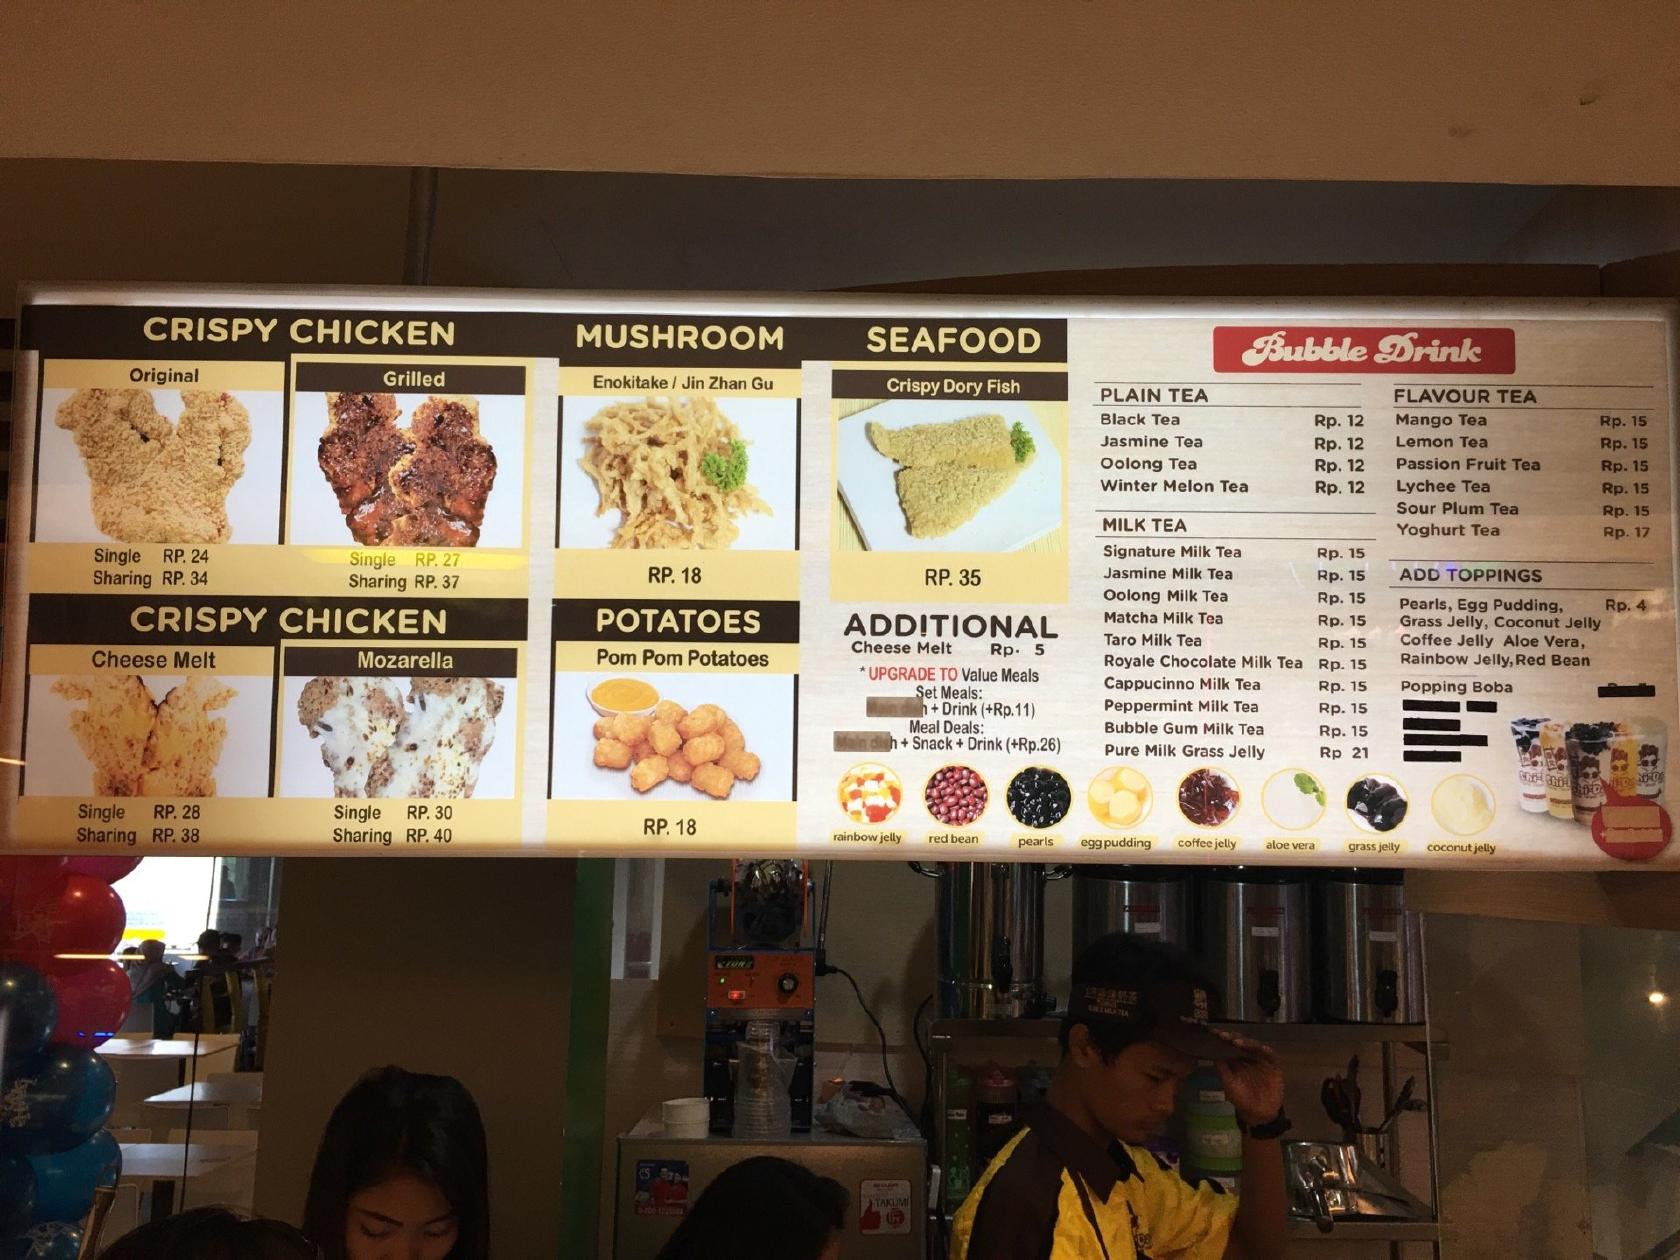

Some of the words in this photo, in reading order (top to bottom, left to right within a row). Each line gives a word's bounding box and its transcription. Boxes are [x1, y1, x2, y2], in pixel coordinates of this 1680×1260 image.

[144, 317, 278, 342] CRISPY
[290, 318, 455, 346] CHICKEN
[577, 324, 783, 350] MUSHROOM
[867, 326, 1041, 354] SEAFOOD
[1241, 331, 1368, 367] Bubble
[1373, 332, 1481, 363] Drink
[129, 367, 199, 385] Original
[383, 371, 445, 387] Grilled
[593, 375, 668, 389] Enokitake
[682, 376, 704, 389] Jin
[709, 376, 747, 390] Zhan
[752, 376, 773, 390] Gu
[887, 378, 940, 396] Crispy
[944, 379, 983, 396] Dory
[987, 379, 1020, 394] Fish
[1101, 388, 1161, 403] PLAIN
[1168, 388, 1208, 403] TEA
[1395, 389, 1490, 404] FLAVOUR
[1496, 389, 1537, 404] TEA
[1101, 413, 1146, 425] Black
[1151, 414, 1180, 426] Tea
[1315, 414, 1341, 429] Rp.
[1347, 414, 1364, 427] 12
[1396, 414, 1453, 429] Mango
[1458, 414, 1487, 427] Tea
[1600, 415, 1626, 429] Rp.
[1631, 416, 1647, 427] 15
[1397, 457, 1460, 470] Passion
[1466, 458, 1507, 471] Fruit
[1511, 457, 1541, 472] Tea
[1100, 479, 1158, 492] Winter
[1163, 479, 1214, 493] Melon
[1220, 480, 1248, 493] Tea
[1103, 518, 1146, 532] MILK
[1151, 518, 1187, 532] TEA
[1397, 523, 1466, 538] Yoghurt
[1470, 523, 1501, 537] Tea
[1604, 526, 1629, 540] Rp.
[1634, 526, 1650, 538] 17
[94, 548, 141, 566] Single
[163, 549, 186, 563] RP.
[191, 549, 209, 563] 24
[1104, 544, 1176, 559] Signature
[1181, 545, 1211, 558] Milk
[1215, 546, 1242, 558] Tea
[1317, 548, 1343, 561] Rp.
[1348, 548, 1365, 559] 15
[93, 570, 152, 589] Sharing
[162, 571, 185, 585] RP.
[190, 571, 208, 585] 34
[648, 566, 675, 584] RP.
[682, 567, 701, 584] 18
[925, 568, 952, 586] RP.
[959, 569, 981, 586] 35
[1400, 568, 1440, 581] ADD
[1446, 568, 1543, 583] TOPPINGS
[1400, 598, 1452, 612] Pearls,
[1458, 598, 1488, 613] Egg
[1493, 598, 1564, 614] Pudding,
[1606, 598, 1631, 613] Rp.
[1636, 599, 1647, 612] 4
[131, 606, 267, 633] CRISPY
[279, 607, 446, 634] CHICKEN
[597, 608, 760, 634] POTATOES
[1400, 615, 1442, 627] Grass
[1447, 615, 1488, 630] Jelly,
[1494, 616, 1560, 629] Coconut
[1565, 616, 1601, 632] Jelly
[851, 640, 911, 654] Cheese
[917, 641, 952, 654] Melt
[1400, 633, 1452, 646] Coffee
[1457, 634, 1494, 649] Jelly
[1503, 634, 1539, 648] Aloe
[1544, 635, 1586, 650] Vera,
[92, 650, 167, 669] Cheese
[174, 651, 216, 669] Melt
[358, 651, 453, 669] Mozarella
[597, 648, 637, 665] Pom
[643, 649, 683, 666] Pom
[688, 649, 769, 667] Potatoes
[1104, 654, 1155, 669] Royale
[1160, 654, 1236, 668] Chocolate
[1242, 655, 1272, 668] Milk
[1277, 656, 1303, 669] Tea
[1401, 653, 1468, 665] Rainbow
[1551, 654, 1590, 667] Bean
[868, 666, 936, 681] UPGRADE
[940, 667, 958, 682] TO
[962, 668, 998, 682] Value
[1001, 668, 1039, 683] Meals
[1104, 676, 1194, 691] Cappucinno
[1200, 677, 1230, 690] Milk
[1235, 678, 1261, 691] Tea
[1401, 680, 1467, 695] Popping
[1473, 681, 1513, 693] Boba
[916, 685, 941, 700] Set
[941, 685, 983, 700] Meals:
[942, 702, 977, 716] Drink
[981, 702, 1035, 719] (+Rp.11)
[1105, 699, 1193, 714] Peppermint
[1199, 700, 1229, 712] Milk
[1233, 701, 1258, 713] Tea
[910, 720, 940, 734] Meal
[944, 720, 984, 734] Deals:
[913, 736, 953, 750] Snack
[968, 736, 1003, 751] Drink
[1006, 737, 1061, 754] (+Rp.26)
[1105, 744, 1140, 757] Pure
[1145, 744, 1176, 757] Milk
[1182, 745, 1224, 758] Grass
[1229, 745, 1265, 760] Jelly
[1320, 746, 1342, 760] Rp
[1352, 747, 1368, 759] 21
[78, 803, 125, 822] Single
[154, 804, 177, 819] RP.
[182, 805, 200, 820] 28
[334, 804, 381, 822] Single
[407, 805, 430, 820] RP.
[435, 805, 452, 820] 30
[644, 818, 669, 835] RP.
[676, 818, 696, 836] 18
[77, 827, 137, 847] Sharing
[152, 828, 176, 843] RP.
[181, 828, 200, 844] 38
[833, 832, 878, 843] rainbow
[879, 833, 902, 845] jelly
[928, 834, 949, 844] red
[951, 834, 979, 844] bean
[1018, 837, 1054, 849] pearls
[1081, 838, 1102, 850] egg
[1104, 837, 1151, 850] pudding
[1178, 838, 1213, 848] coffee
[1214, 838, 1236, 850] jelly
[1266, 841, 1290, 850] aloe
[1293, 841, 1315, 850] vera
[1348, 843, 1376, 853] grass
[1378, 842, 1400, 854] jelly
[1427, 843, 1472, 852] coconut
[1473, 844, 1496, 855] jelly
